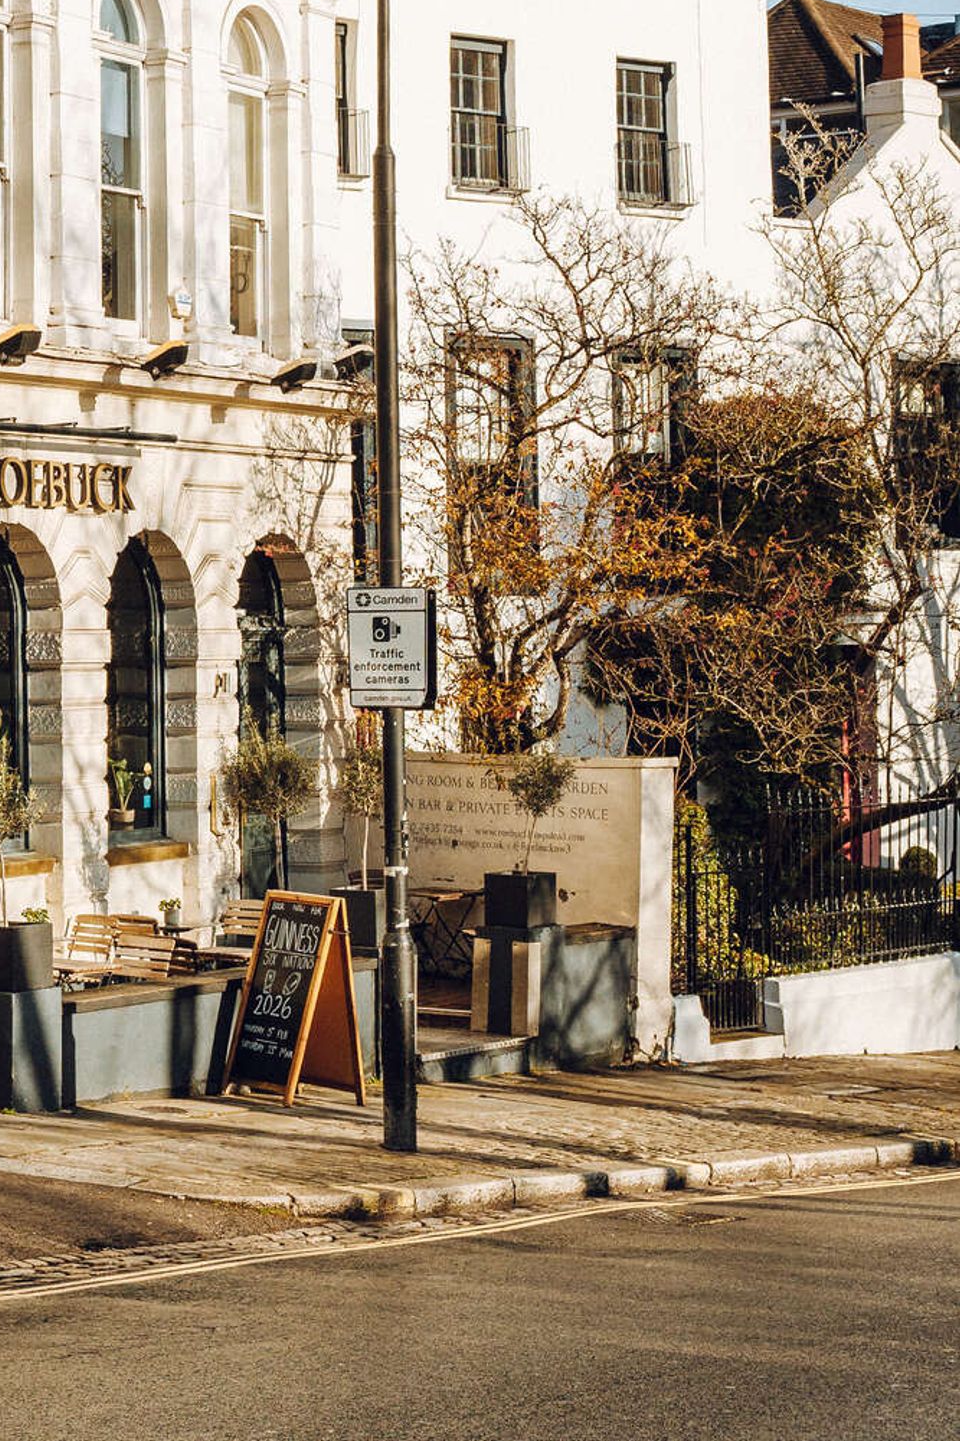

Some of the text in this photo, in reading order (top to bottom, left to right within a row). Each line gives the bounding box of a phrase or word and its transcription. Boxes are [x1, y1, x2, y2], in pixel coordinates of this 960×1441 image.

[373, 594, 418, 605] Camden
[370, 648, 404, 659] Traffic
[354, 661, 421, 671] enforcement
[365, 675, 410, 684] cameras
[427, 775, 462, 788] ROOM
[466, 776, 475, 788] &
[418, 798, 441, 811] BAR
[459, 801, 510, 815] PRIVATE
[570, 806, 608, 821] SPACE
[264, 913, 320, 954] GUINNESS
[263, 951, 315, 970] SIX NATIONS
[253, 994, 292, 1019] 2026
